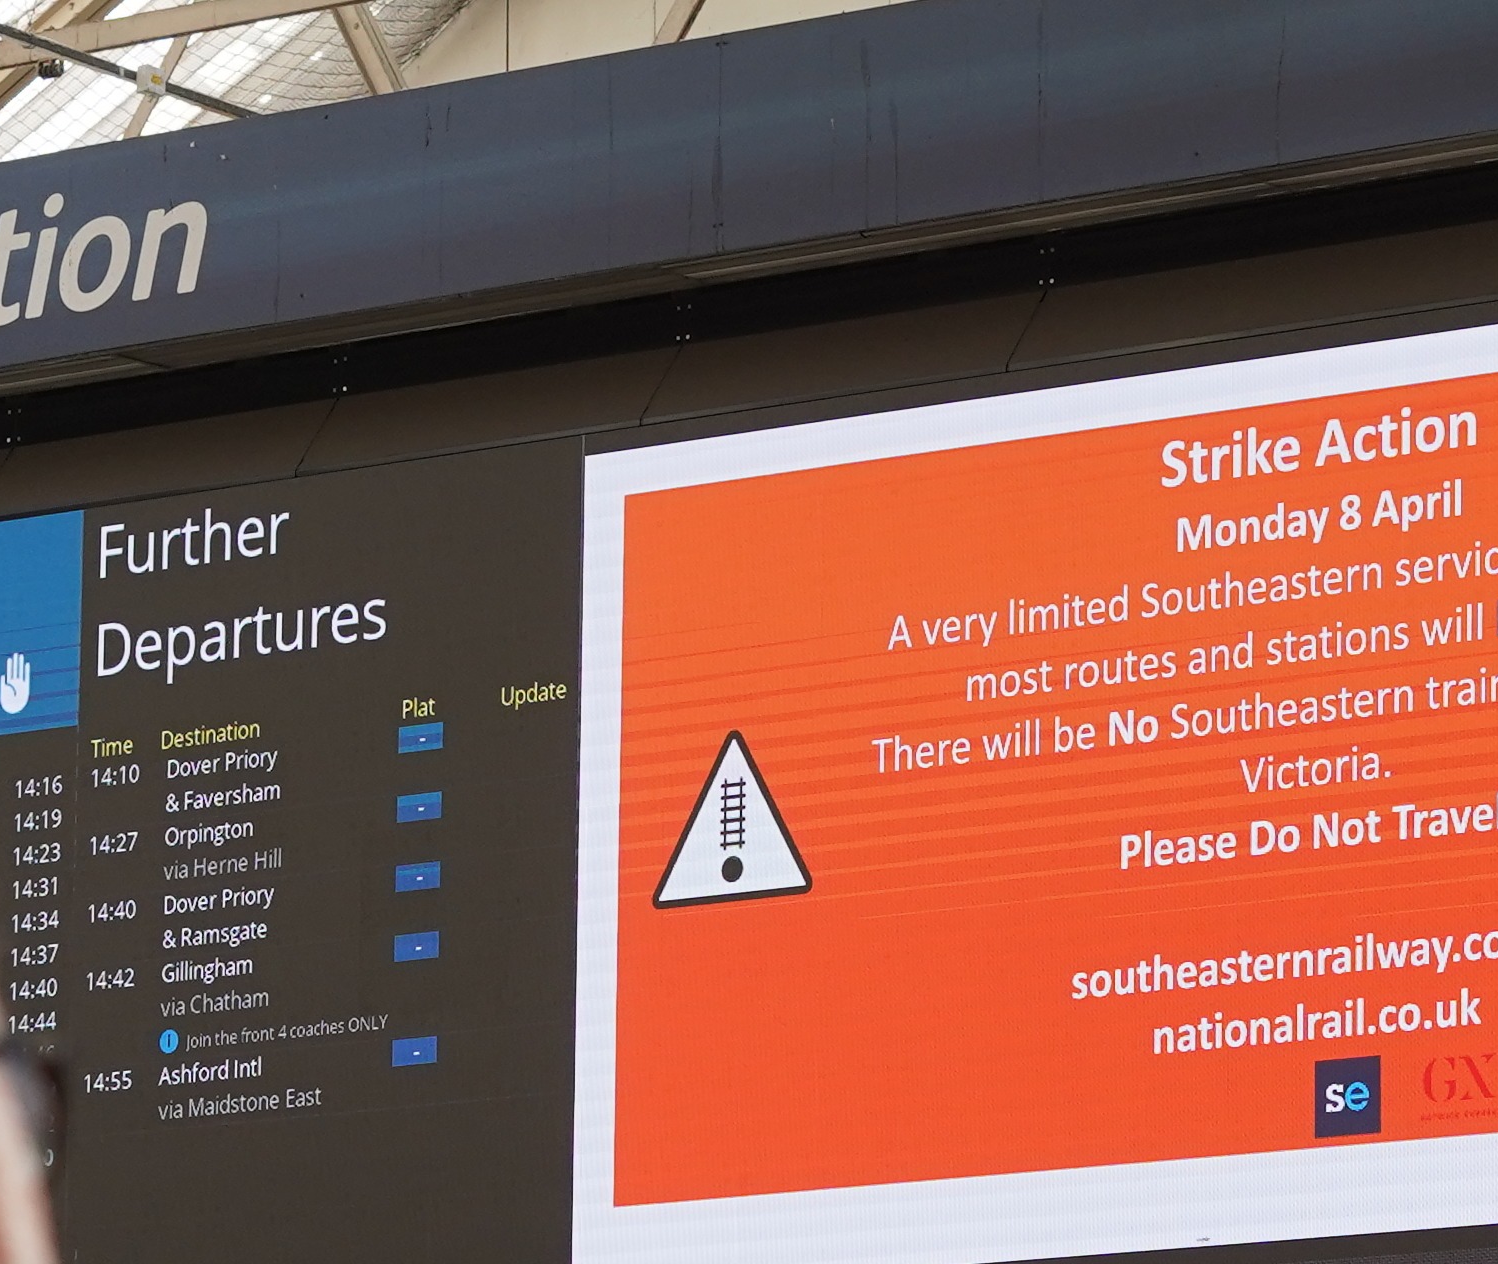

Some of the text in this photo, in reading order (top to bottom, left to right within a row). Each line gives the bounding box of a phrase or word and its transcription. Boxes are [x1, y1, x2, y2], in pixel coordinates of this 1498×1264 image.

[1161, 404, 1478, 488] Strike Action
[99, 508, 290, 579] Further
[887, 615, 913, 651] A
[922, 611, 998, 648] very
[1009, 584, 1129, 635] limited
[1141, 562, 1382, 619] Southeastern
[97, 598, 387, 685] Departures
[90, 681, 567, 759] Time Destination Plat Update
[15, 774, 63, 799] 14:16
[91, 749, 278, 788] 14:10 Dover Priory
[1239, 745, 1391, 793] Victoria.
[165, 782, 281, 813] & Faversham
[163, 847, 282, 881] via Herne Hill
[1120, 830, 1237, 870] Please
[1250, 820, 1301, 856] Do
[1313, 810, 1382, 850] Not
[12, 876, 58, 900] 14:31
[11, 943, 59, 967] 14:37
[185, 1014, 389, 1052] Join the front 4 coaches ONLY
[1153, 987, 1482, 1055] nationalrail.co.uk
